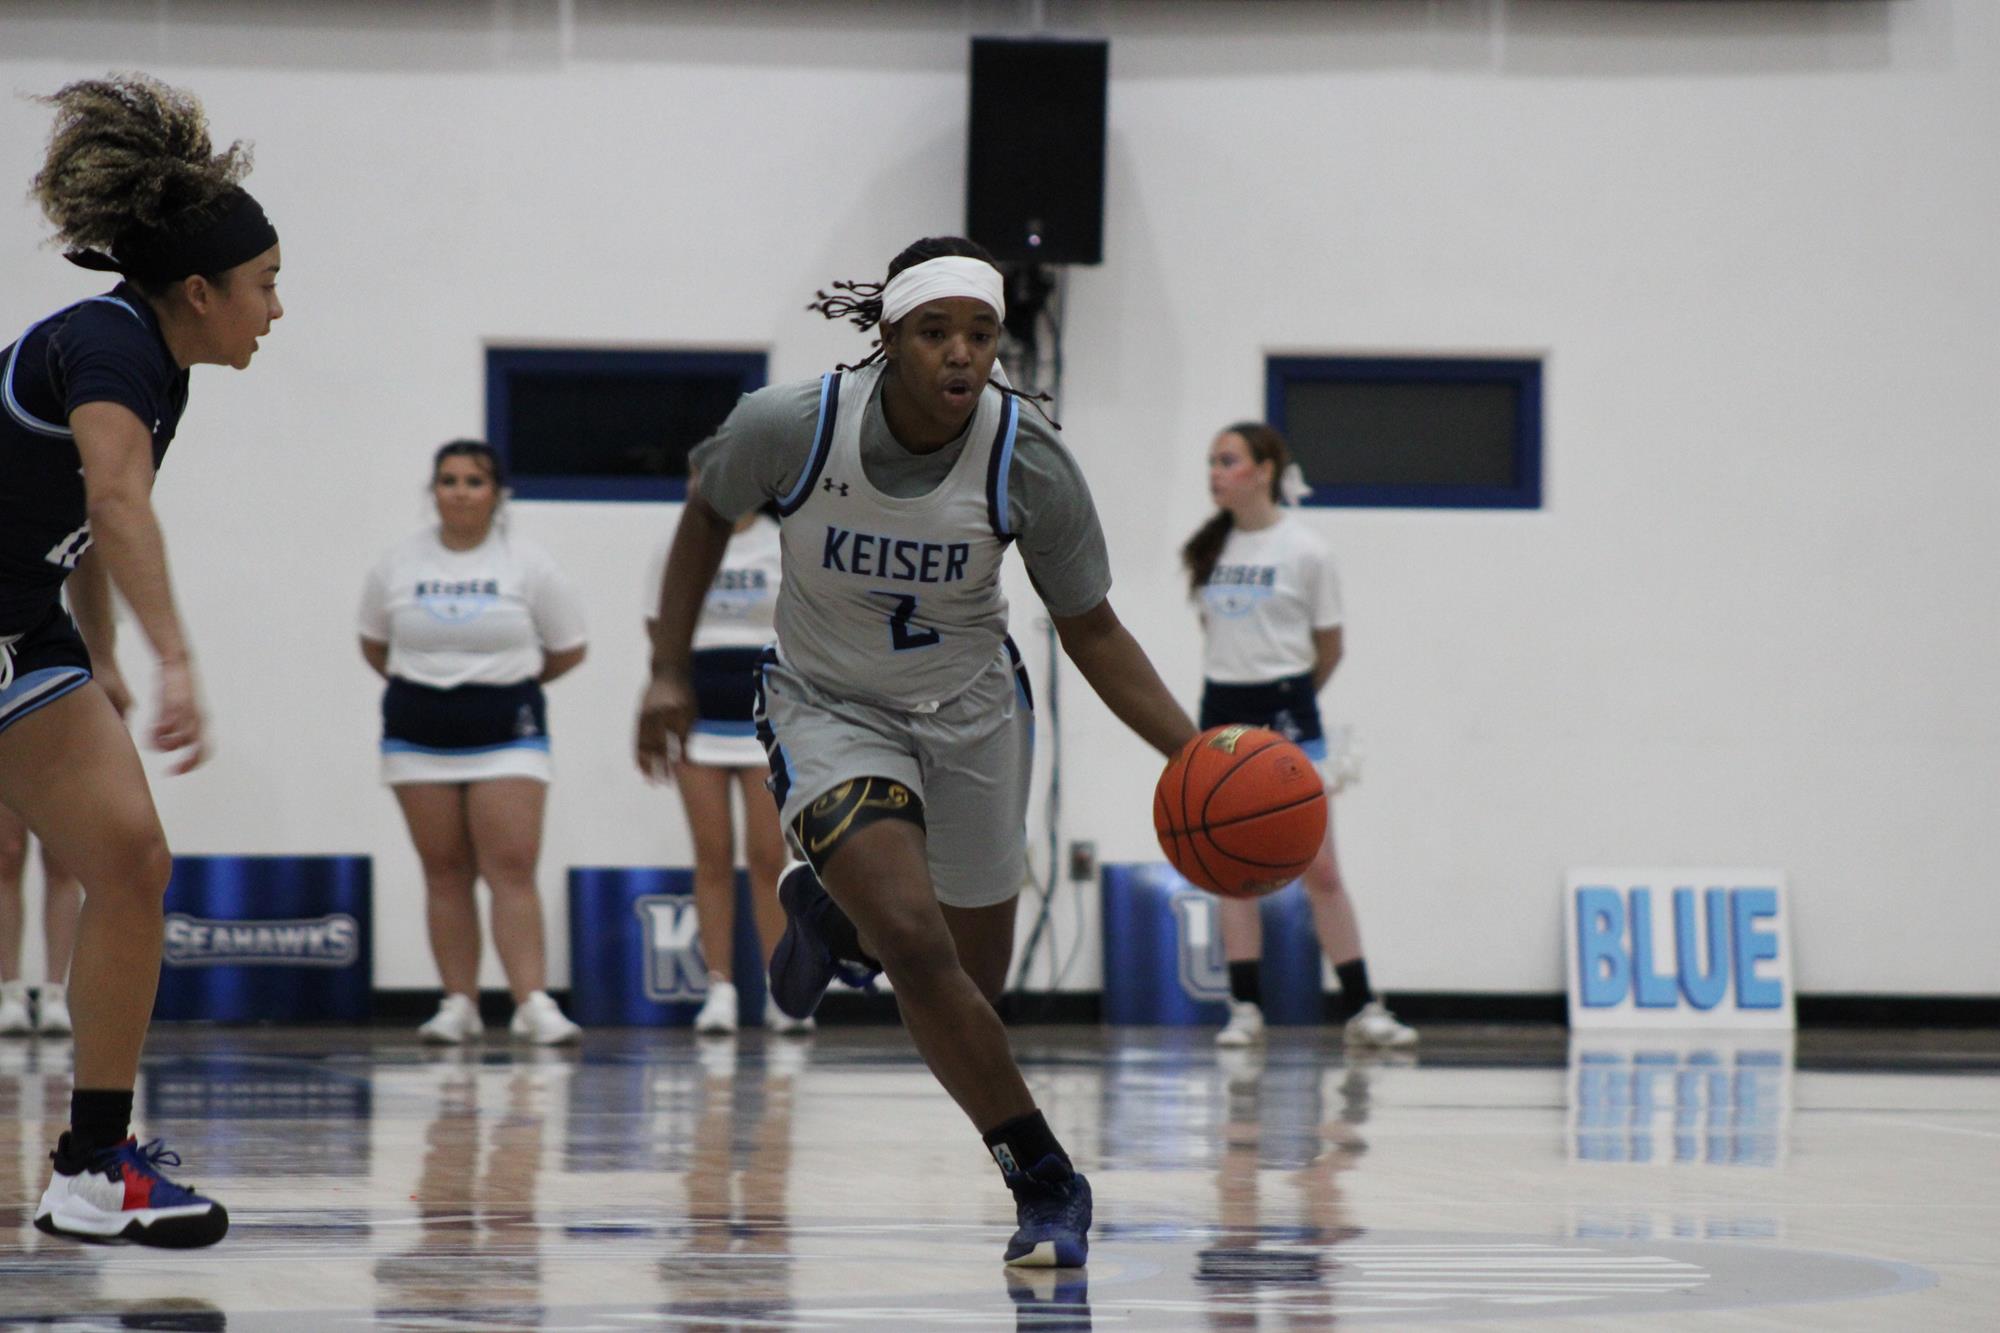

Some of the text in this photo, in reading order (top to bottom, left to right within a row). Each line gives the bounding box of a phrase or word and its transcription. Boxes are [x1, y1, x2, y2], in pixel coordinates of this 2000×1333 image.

[822, 526, 969, 583] KEISER
[1207, 565, 1275, 587] EISER
[868, 589, 941, 651] 2
[164, 918, 355, 958] SEAHAWKS
[646, 902, 712, 993] K
[1576, 885, 1784, 1010] BLUE
